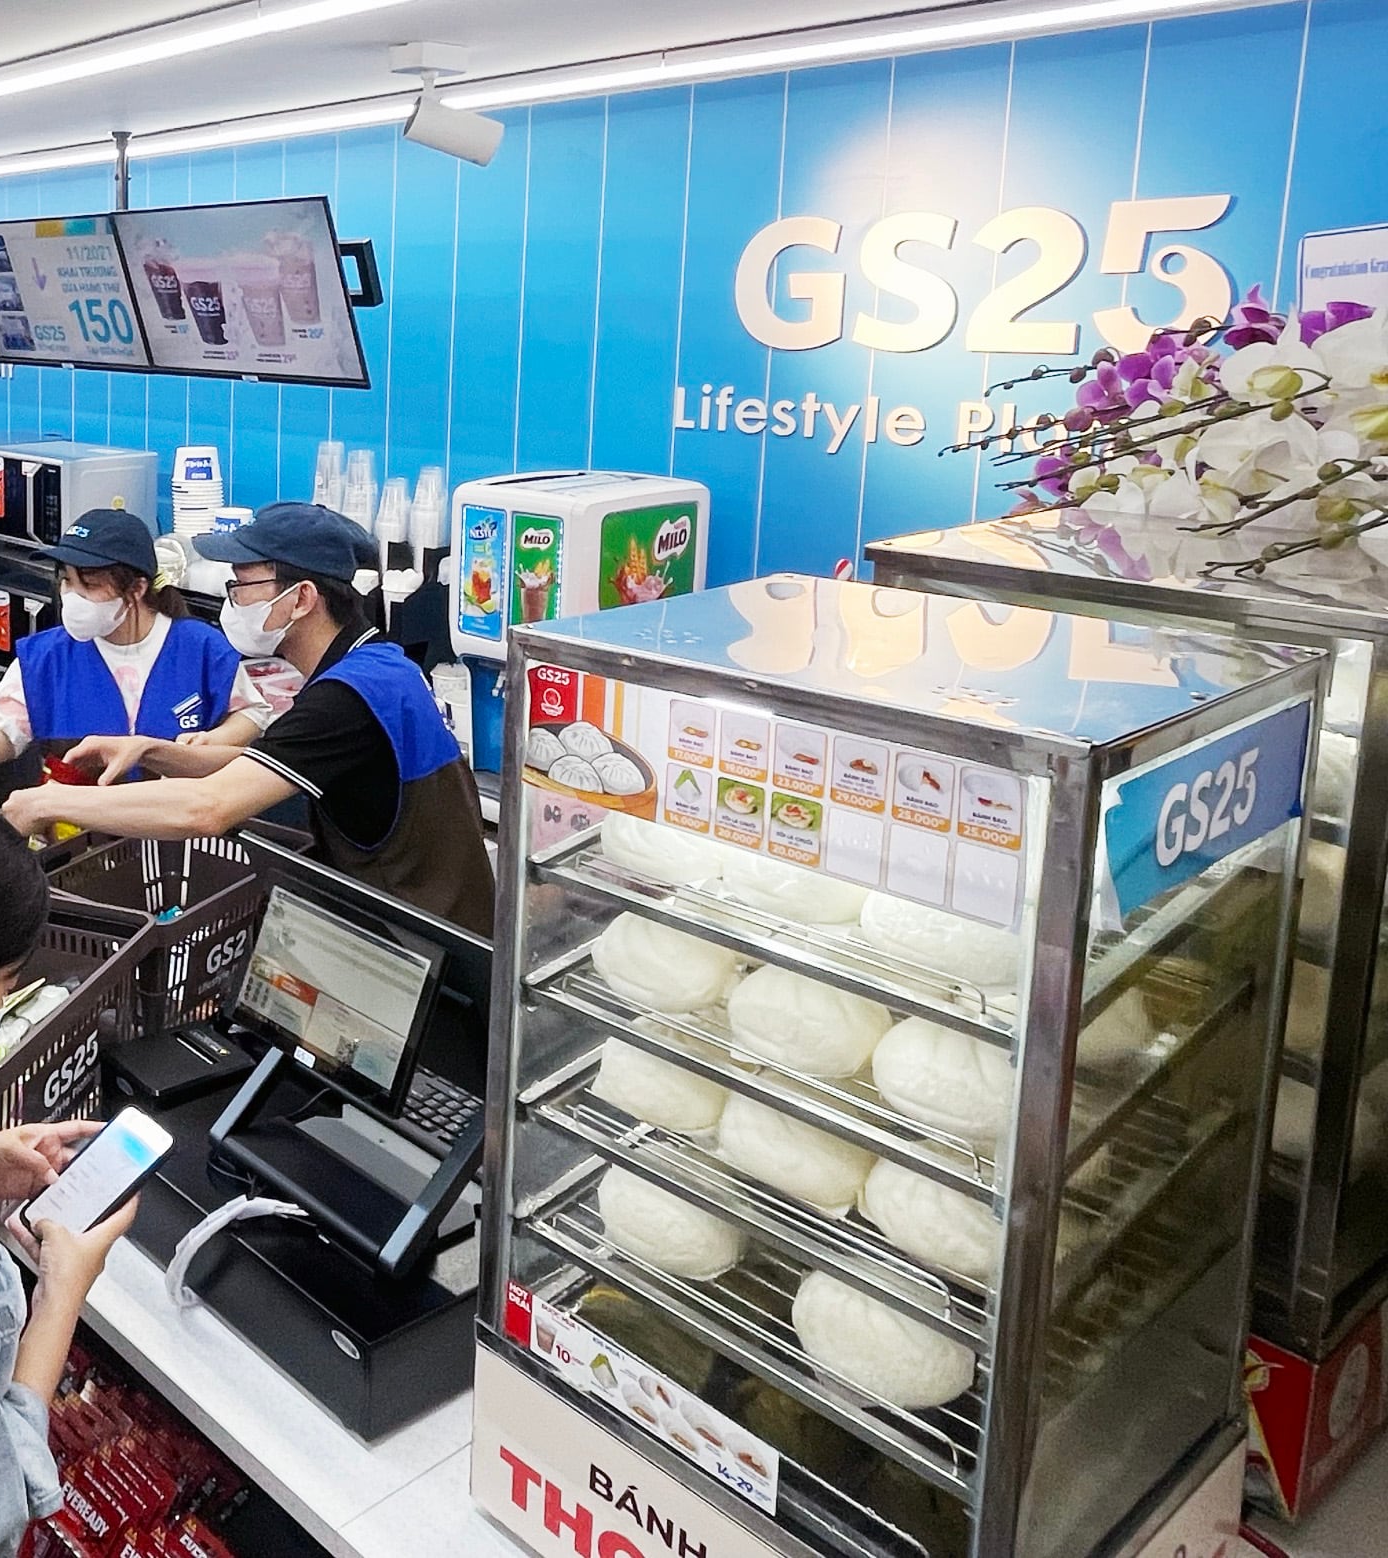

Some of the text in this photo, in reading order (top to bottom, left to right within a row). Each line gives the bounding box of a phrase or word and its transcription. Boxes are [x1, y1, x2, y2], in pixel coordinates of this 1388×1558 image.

[150, 273, 179, 289] GS25
[734, 194, 1234, 356] GS25
[189, 294, 222, 314] GS25
[34, 325, 66, 341] GS25
[69, 299, 134, 345] 150
[674, 384, 927, 454] Lifestyle
[523, 534, 551, 545] MILO
[657, 528, 687, 554] MILO
[537, 668, 570, 685] GS25
[1156, 747, 1259, 866] GS25
[206, 929, 247, 974] GS2
[44, 1029, 99, 1107] GS25
[508, 1291, 531, 1313] DEAL
[509, 1282, 529, 1300] HOT
[62, 1481, 110, 1538] EVEREADY
[589, 1463, 707, 1558] BÁNH
